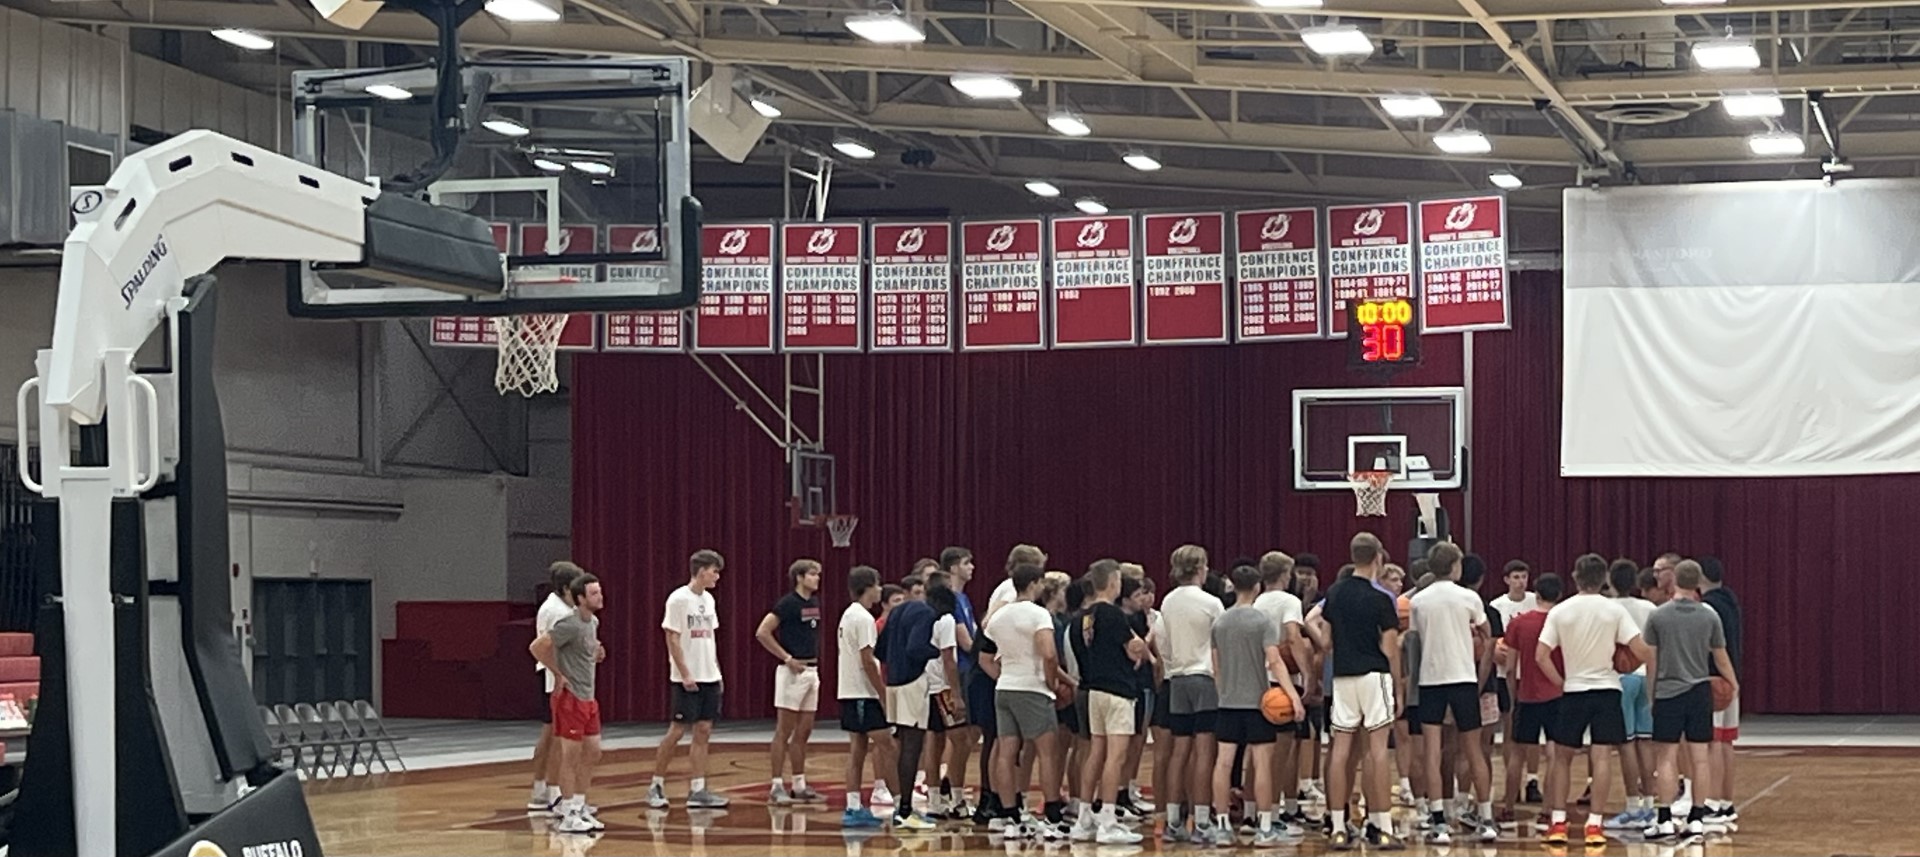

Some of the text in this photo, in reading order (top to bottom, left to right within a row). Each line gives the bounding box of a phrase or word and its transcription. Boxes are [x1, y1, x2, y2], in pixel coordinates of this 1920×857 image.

[1332, 247, 1407, 262] CONFERENCE
[1424, 240, 1501, 256] CONFERENCE
[1057, 259, 1129, 273] CONFERENCE
[1148, 256, 1221, 270] CONFERENCE
[1240, 251, 1314, 267] CONFERENCE
[1424, 253, 1501, 270] CHAMPIONS
[121, 233, 168, 310] SPALDING
[786, 267, 857, 278] CONFERENCE
[875, 266, 946, 277] CONFERENCE
[966, 263, 1037, 276] CONFERENCE
[1241, 264, 1315, 279] CHAMPIONS
[1332, 260, 1408, 275] CHAMPIONS
[966, 276, 1038, 289] CHAMPIONS
[1057, 273, 1130, 287] CHAMPIONS
[1148, 270, 1221, 283] CHAMPIONS
[786, 279, 857, 291] CHAMPIONS
[875, 279, 947, 290] CHAMPIONS
[1357, 301, 1412, 325] 10:00
[1362, 325, 1404, 361] 30
